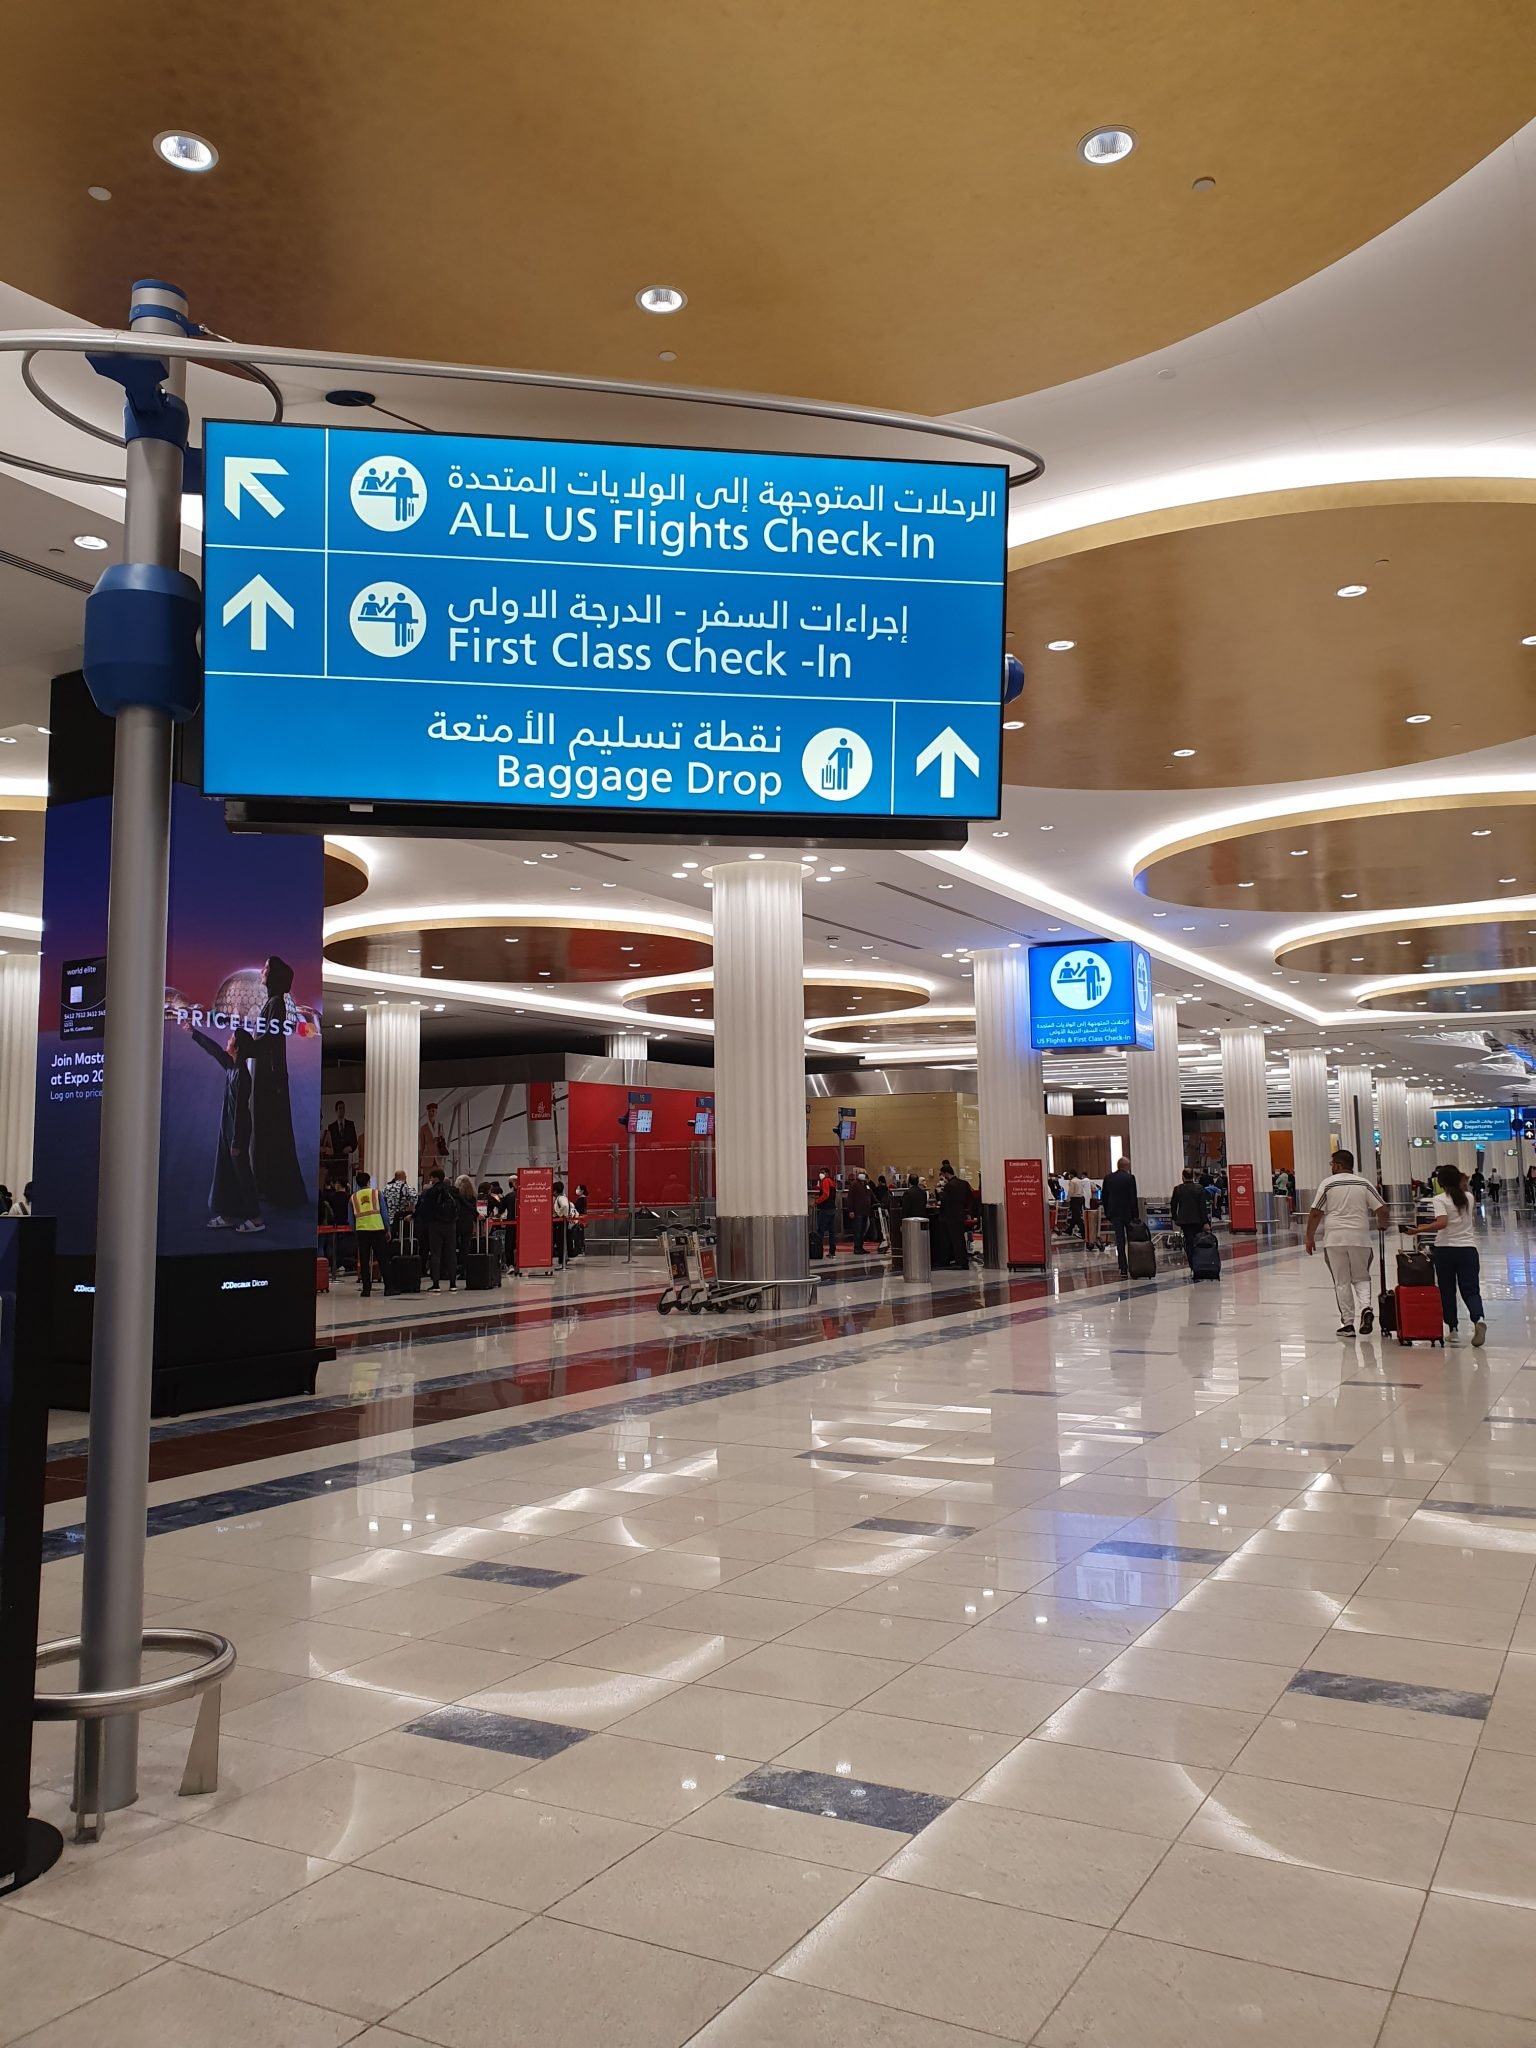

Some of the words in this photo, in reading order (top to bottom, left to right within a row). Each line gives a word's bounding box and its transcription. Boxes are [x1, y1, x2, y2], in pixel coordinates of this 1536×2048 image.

[448, 464, 556, 494] المتحدة
[567, 469, 685, 507] الولايات
[696, 478, 748, 513] إلى
[758, 481, 884, 517] المتوجهة
[894, 488, 996, 523] الرحلات
[449, 501, 529, 539] ALL
[545, 506, 597, 543] US
[614, 508, 749, 557] Flights
[763, 516, 935, 559] Check-In
[569, 593, 661, 629] الدرجة
[695, 600, 788, 634] السفر
[799, 603, 907, 644] إجراءات
[449, 627, 537, 666] First
[552, 631, 651, 671] Class
[666, 636, 787, 676] Check
[427, 710, 555, 745] الأمتعة
[568, 715, 683, 761] تسليم
[693, 719, 781, 753] نقطة
[498, 754, 673, 802] Baggage
[688, 761, 782, 805] Drop
[67, 967, 83, 976] world
[84, 966, 97, 974] elite
[176, 1008, 294, 1036] PRICELESS
[1046, 1037, 1066, 1045] Flights
[1104, 1034, 1131, 1042] Check-In
[51, 1054, 73, 1067] Join
[50, 1074, 62, 1085] at
[64, 1071, 90, 1087] Expo
[50, 1091, 64, 1101] Log
[65, 1091, 75, 1099] on
[75, 1090, 84, 1098] to
[221, 1281, 251, 1290] JCDecaux
[252, 1279, 269, 1288] Dicon
